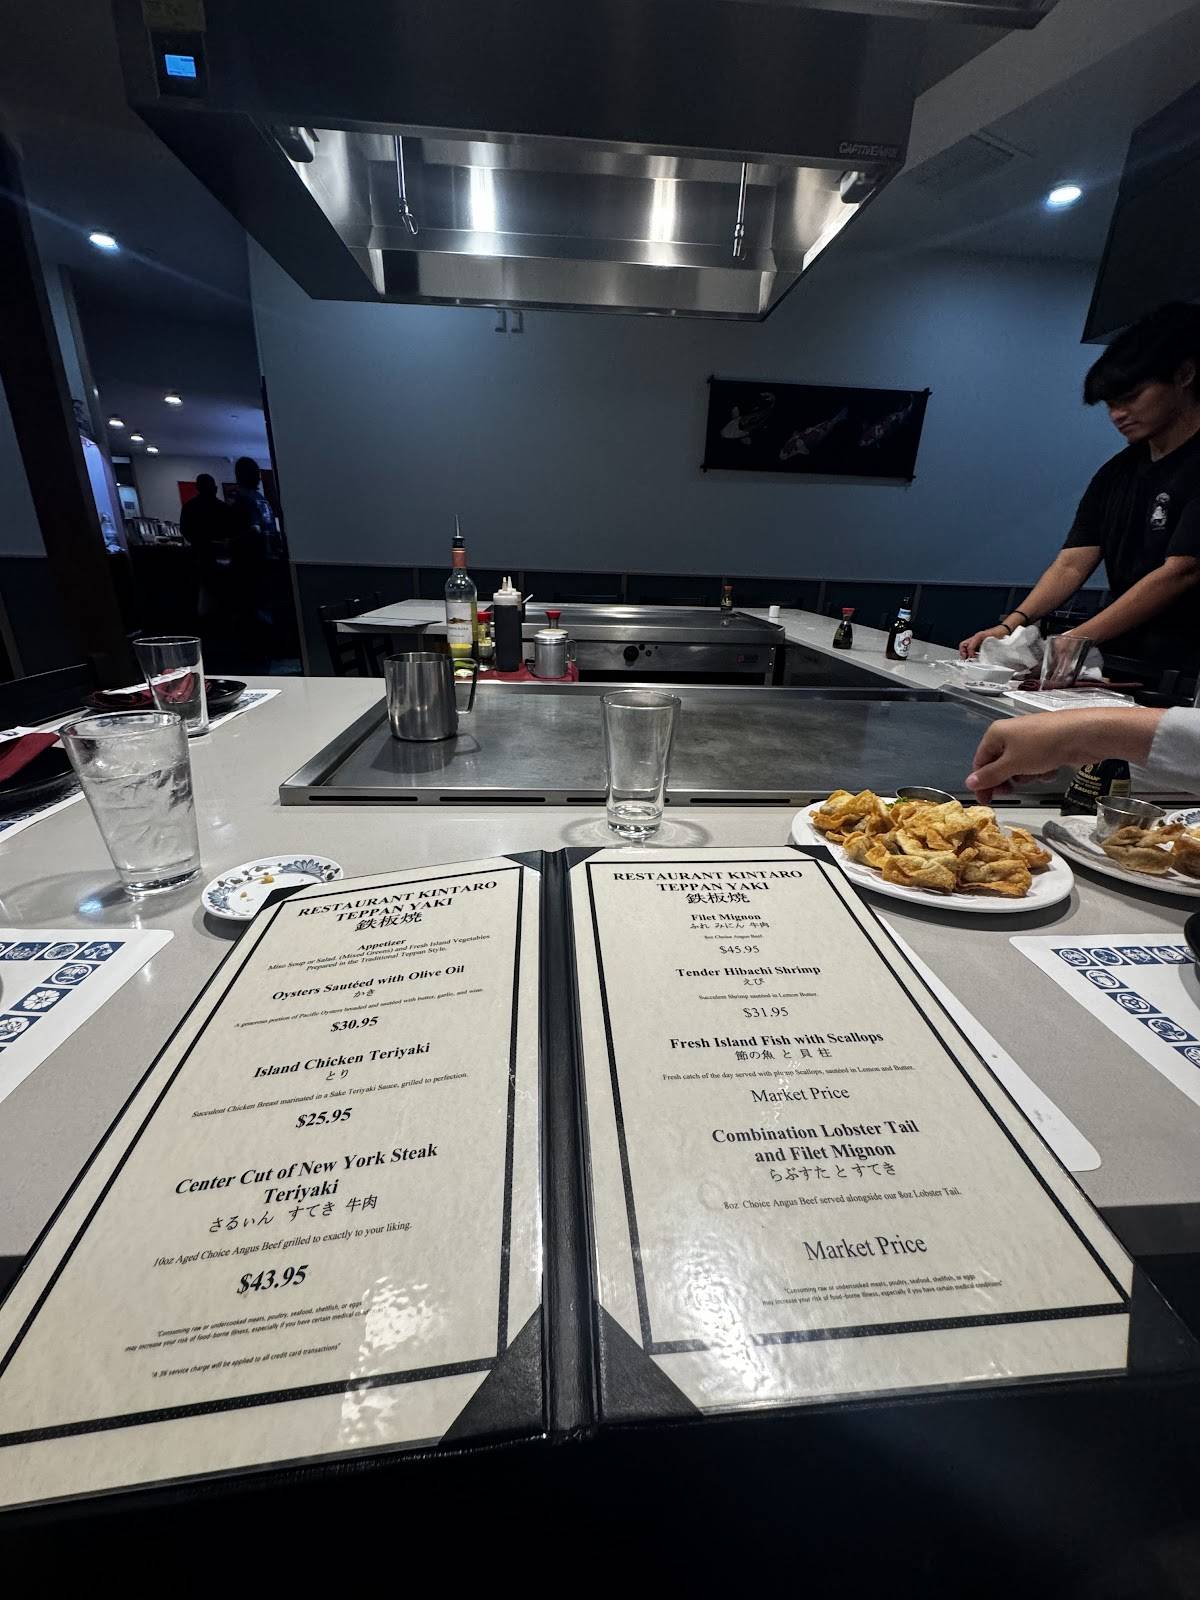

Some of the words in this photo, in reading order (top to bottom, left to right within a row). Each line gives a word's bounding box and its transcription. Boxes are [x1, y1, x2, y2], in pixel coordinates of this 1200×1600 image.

[613, 872, 722, 881] RESTAURANT
[727, 870, 803, 880] KINTARO
[656, 883, 723, 892] TEPPAN
[726, 882, 770, 891] YAKI
[298, 892, 415, 917] RESTAURANT
[418, 881, 498, 899] KINTARO
[685, 892, 751, 904] 鉄板焼
[336, 904, 404, 922] TEPPAN
[410, 897, 453, 911] YAKI
[719, 913, 762, 922] Mignon
[354, 911, 423, 932] 鉄板焼
[316, 956, 337, 964] Salad.
[338, 951, 366, 961] (Mixed
[366, 948, 394, 956] Greens)
[409, 942, 429, 950] Fresh
[430, 939, 452, 947] Island
[453, 934, 490, 944] Vegetables
[358, 939, 407, 951] Appetizer
[719, 945, 760, 955] $45.95
[306, 961, 338, 972] Prepared
[361, 952, 399, 963] Traditional
[401, 949, 427, 958] Teppan
[675, 968, 721, 977] Tender
[724, 966, 774, 976] Hibachi
[774, 966, 821, 976] Shrimp
[743, 977, 766, 986] えび
[272, 988, 321, 1001] Oysters
[323, 978, 374, 993] Sautéed
[378, 974, 405, 985] with
[408, 970, 442, 980] Olive
[445, 965, 465, 975] Oil
[353, 988, 376, 999] かき
[742, 1006, 789, 1018] $31.95
[330, 1016, 379, 1033] $30.95
[670, 1038, 711, 1049] Fresh
[714, 1036, 759, 1048] Island
[760, 1035, 792, 1046] Fish
[794, 1034, 826, 1045] with
[827, 1032, 884, 1045] Scallops
[254, 1061, 301, 1078] Island
[304, 1055, 364, 1070] Chicken
[369, 1042, 430, 1061] Teriyaki
[721, 1072, 734, 1080] day
[794, 1068, 825, 1077] Scallops,
[191, 1108, 227, 1118] Succulent
[226, 1104, 256, 1113] Chicken
[256, 1100, 280, 1109] Breast
[279, 1094, 315, 1105] marinated
[329, 1090, 347, 1098] Sake
[348, 1085, 377, 1095] Teriyaki
[377, 1083, 400, 1092] Sauce,
[400, 1078, 424, 1089] grilled
[432, 1073, 468, 1084] perfection.
[750, 1088, 809, 1103] Market
[809, 1086, 851, 1100] Price
[295, 1107, 353, 1129] $25.95
[712, 1126, 819, 1143] Combination
[820, 1124, 882, 1138] Lobster
[883, 1120, 921, 1134] Tail
[755, 1148, 787, 1163] and
[789, 1146, 830, 1161] Filet
[830, 1144, 897, 1162] Mignon
[175, 1176, 237, 1195] Center
[240, 1168, 274, 1185] Cut
[276, 1163, 299, 1180] of
[298, 1160, 338, 1177] New
[344, 1151, 386, 1170] York
[390, 1143, 438, 1163] Steak
[770, 1166, 831, 1183] らぶすた
[835, 1164, 848, 1179] と
[851, 1162, 896, 1178] すてき
[264, 1179, 340, 1205] Teriyaki
[723, 1201, 740, 1210] 8oz
[742, 1200, 772, 1209] Choice
[773, 1199, 799, 1209] Angus
[798, 1196, 819, 1206] Beef
[819, 1194, 846, 1205] served
[846, 1192, 884, 1204] alongside
[897, 1191, 914, 1199] 8oz
[912, 1189, 943, 1198] Lobster
[942, 1187, 963, 1196] Tail.
[288, 1201, 336, 1223] すてき
[345, 1194, 378, 1213] 牛肉
[153, 1257, 175, 1268] 10oz
[175, 1252, 201, 1266] Aged
[200, 1248, 231, 1261] Choice
[231, 1245, 260, 1256] Angus
[261, 1239, 284, 1252] Beef
[282, 1235, 312, 1251] grilled
[322, 1230, 354, 1242] exactly
[355, 1229, 364, 1238] to
[364, 1226, 385, 1238] your
[386, 1221, 413, 1232] liking.
[803, 1238, 876, 1261] Market
[875, 1235, 928, 1256] Price
[236, 1264, 309, 1295] $43.95
